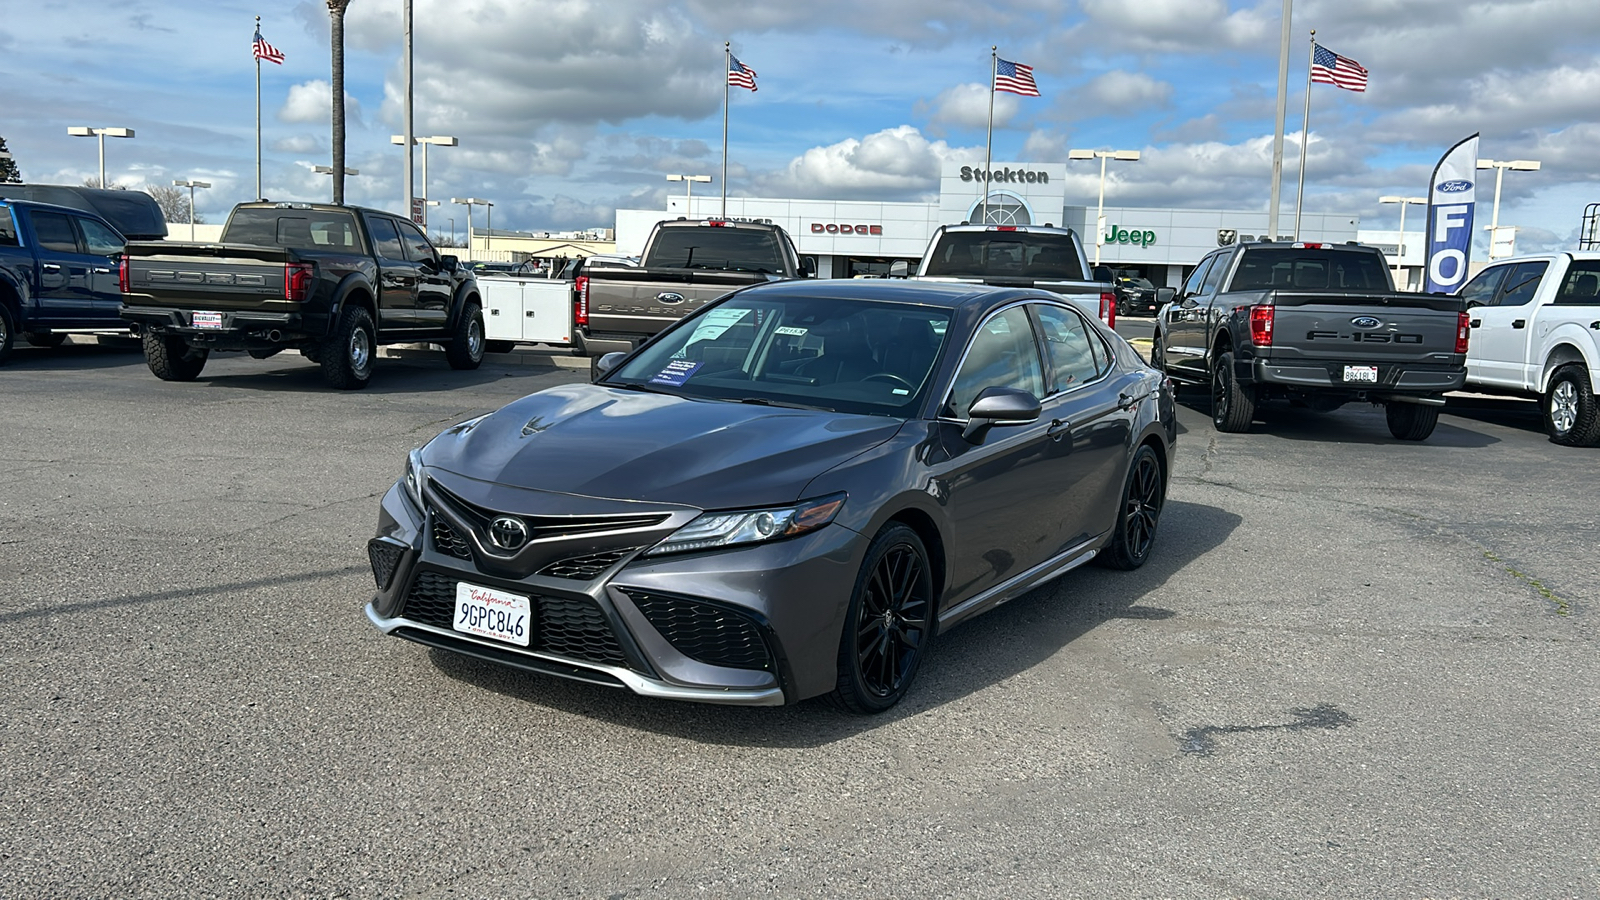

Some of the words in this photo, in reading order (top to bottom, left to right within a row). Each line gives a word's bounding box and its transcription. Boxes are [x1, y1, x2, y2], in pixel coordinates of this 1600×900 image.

[960, 165, 1049, 185] Stockton
[1443, 181, 1467, 192] Ford
[811, 223, 883, 236] DODGE
[1104, 224, 1156, 248] Jeep
[1429, 204, 1468, 286] FO
[146, 270, 266, 286] FORD
[598, 303, 678, 315] SUPER
[1306, 330, 1424, 345] F-150
[471, 589, 516, 609] California
[459, 602, 525, 637] 9GPC846
[472, 627, 511, 640] dmv.ca.gov
